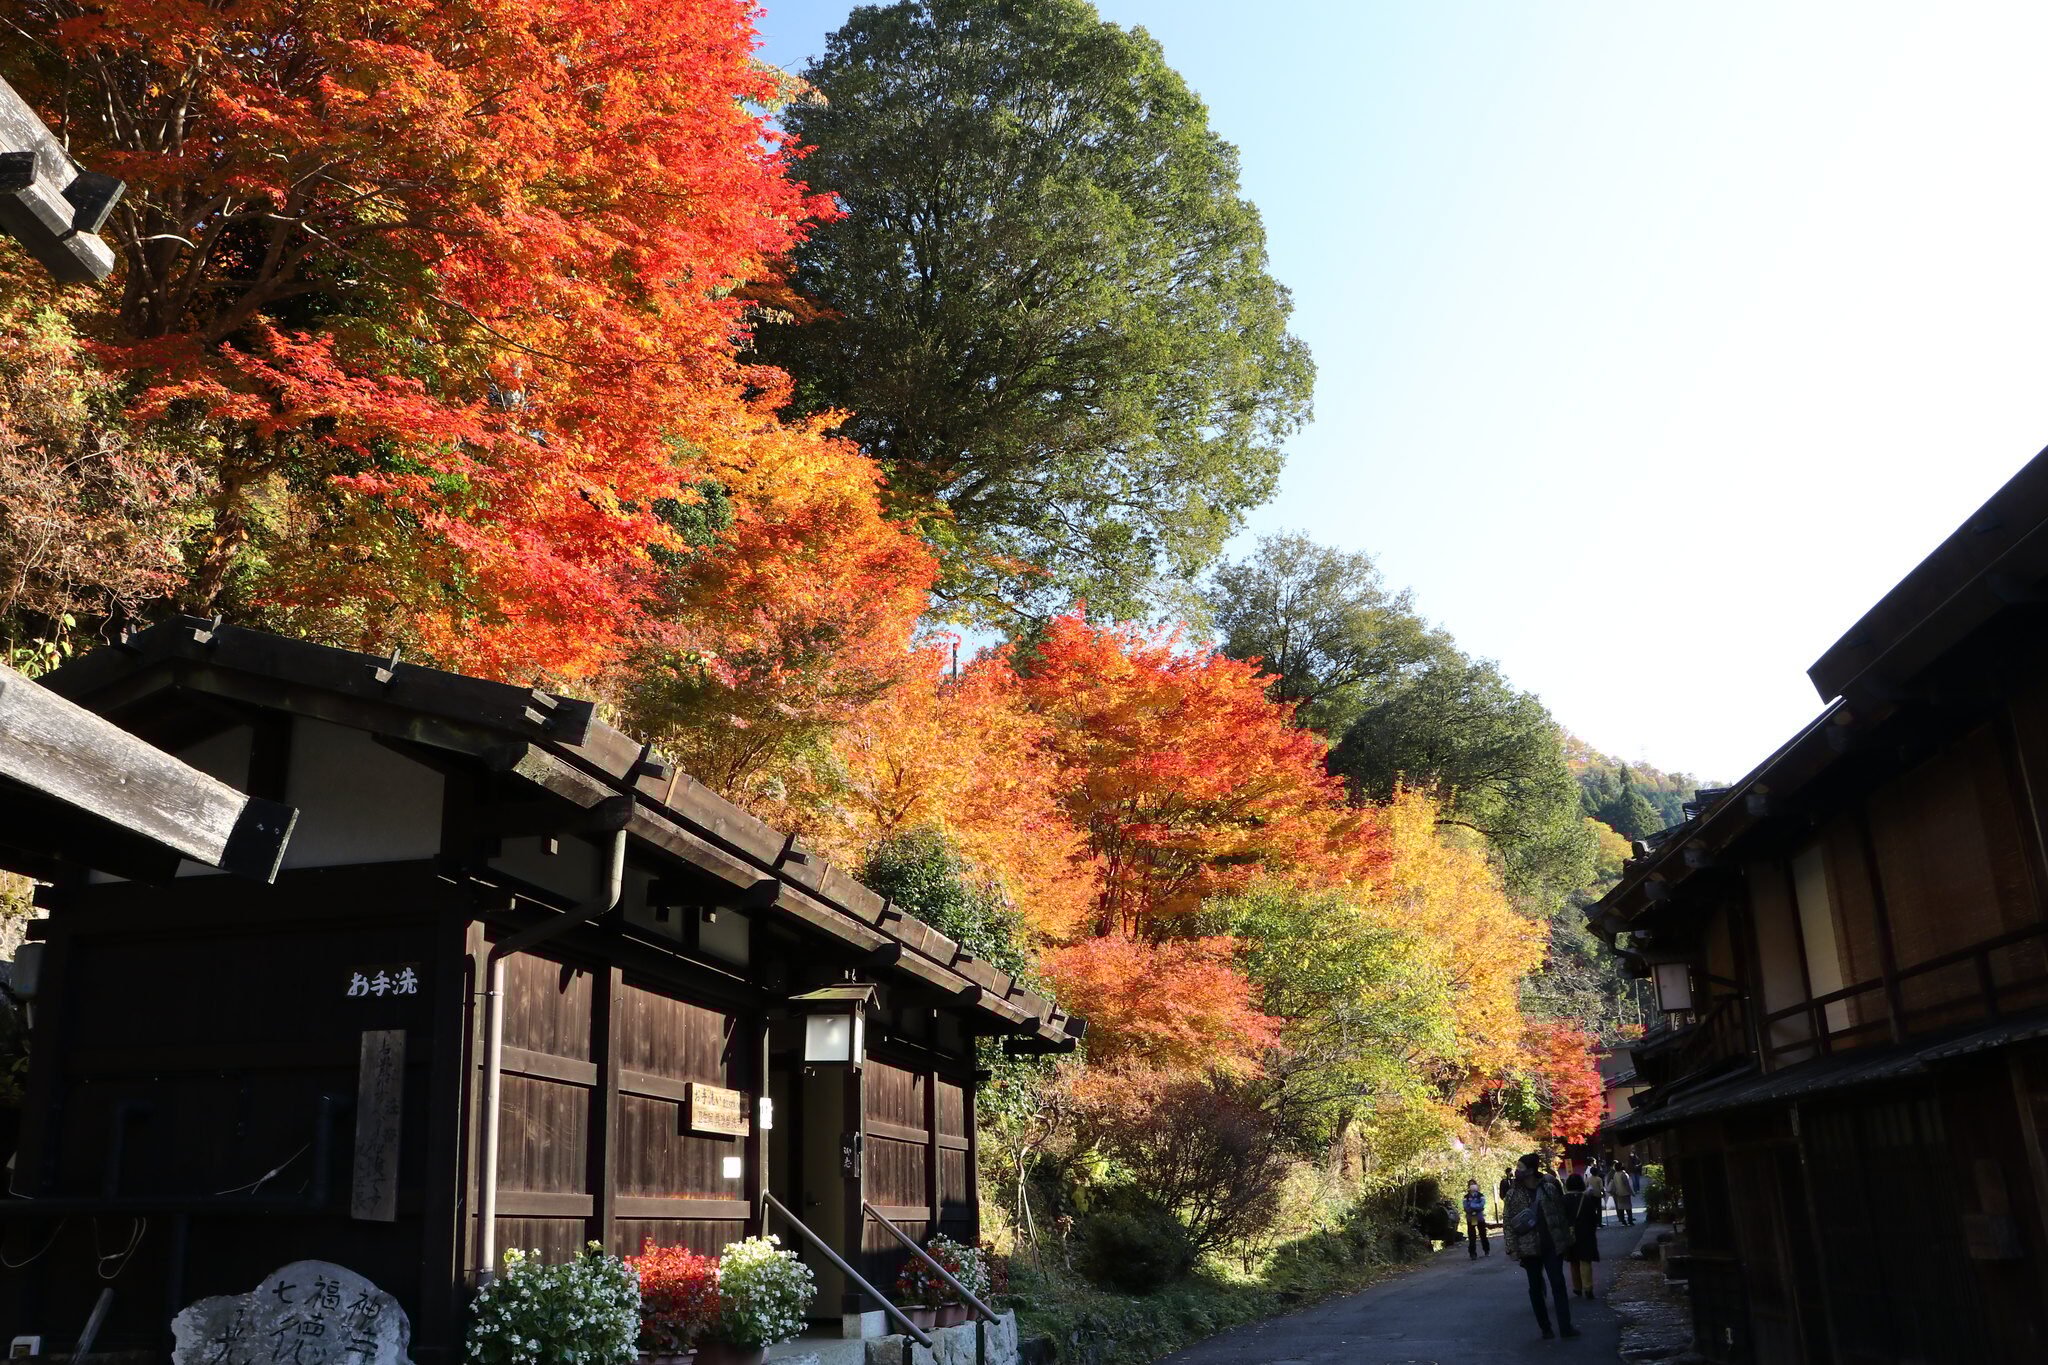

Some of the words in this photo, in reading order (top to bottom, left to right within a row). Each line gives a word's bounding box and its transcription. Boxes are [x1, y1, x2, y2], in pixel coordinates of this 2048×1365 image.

[347, 966, 418, 997] お手洗
[272, 1275, 381, 1321] 七福神
